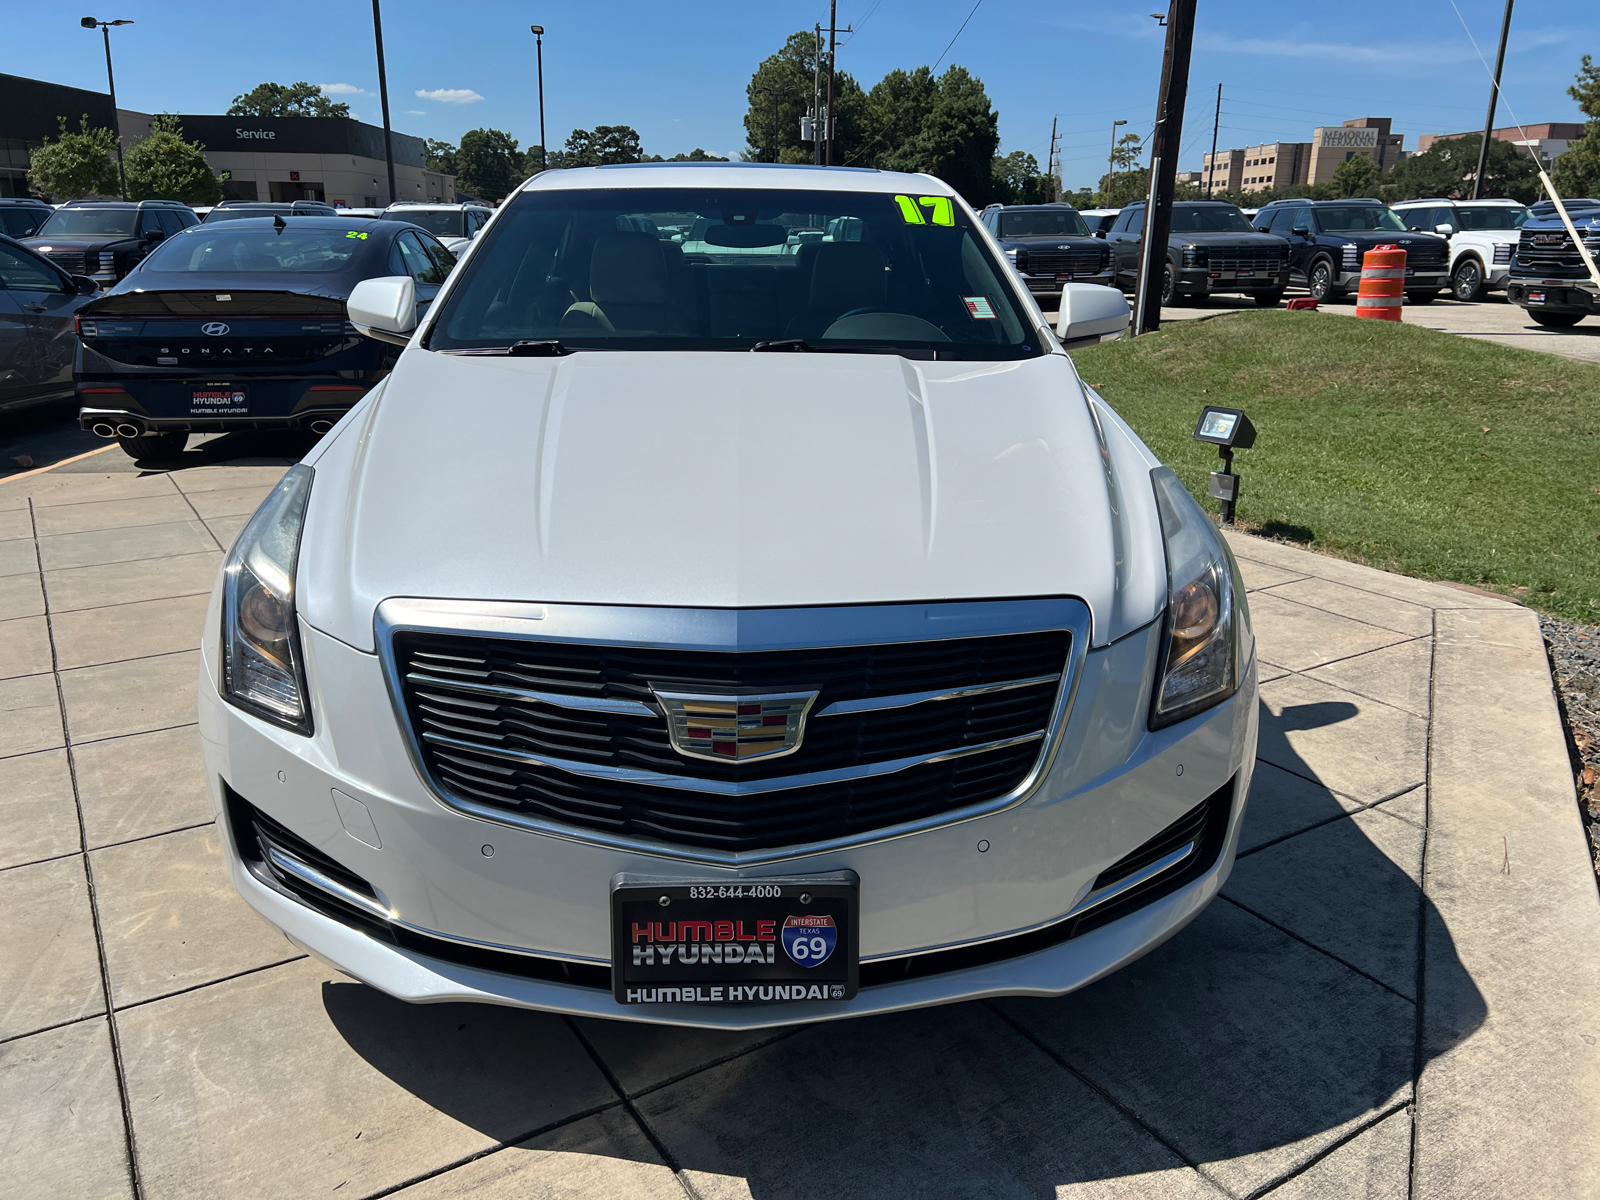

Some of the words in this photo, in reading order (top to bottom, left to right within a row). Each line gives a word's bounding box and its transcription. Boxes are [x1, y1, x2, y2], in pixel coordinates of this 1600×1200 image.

[235, 128, 276, 140] Service
[1324, 131, 1375, 139] MEMORIAL
[1323, 138, 1375, 146] HERMANN
[894, 195, 956, 227] 17
[346, 230, 369, 241] 24
[1533, 234, 1564, 244] GMC
[193, 397, 231, 405] HYUNDAI
[689, 885, 782, 899] 832-644-4000
[790, 918, 828, 926] INTERSTATE
[631, 920, 776, 943] HUMBLE
[792, 936, 827, 960] 69
[632, 943, 776, 966] HYUNDAI
[626, 986, 723, 1003] HUMBLE
[728, 985, 829, 1001] HYUNDAI
